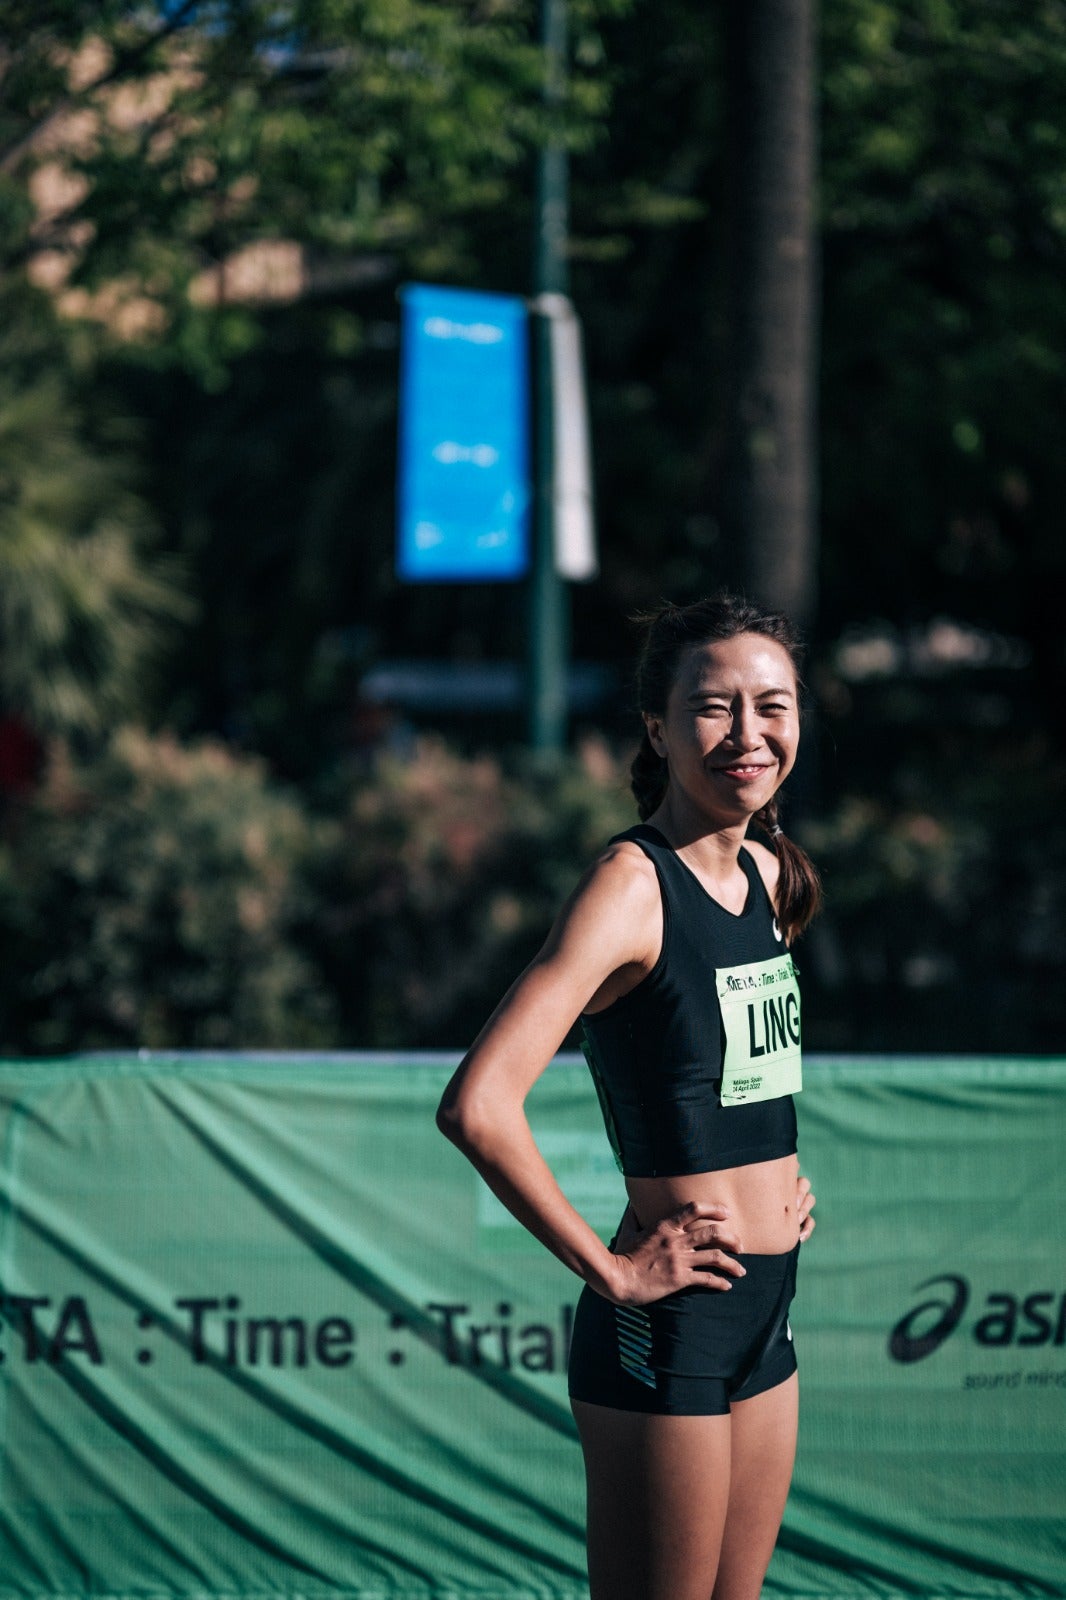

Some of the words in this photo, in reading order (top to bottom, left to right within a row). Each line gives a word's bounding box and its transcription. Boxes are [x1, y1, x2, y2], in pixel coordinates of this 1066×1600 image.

[762, 972, 774, 986] Time
[747, 992, 800, 1058] LING
[738, 1084, 750, 1092] April
[0, 1294, 103, 1366] TA
[175, 1296, 355, 1368] Time
[426, 1303, 573, 1374] Trial
